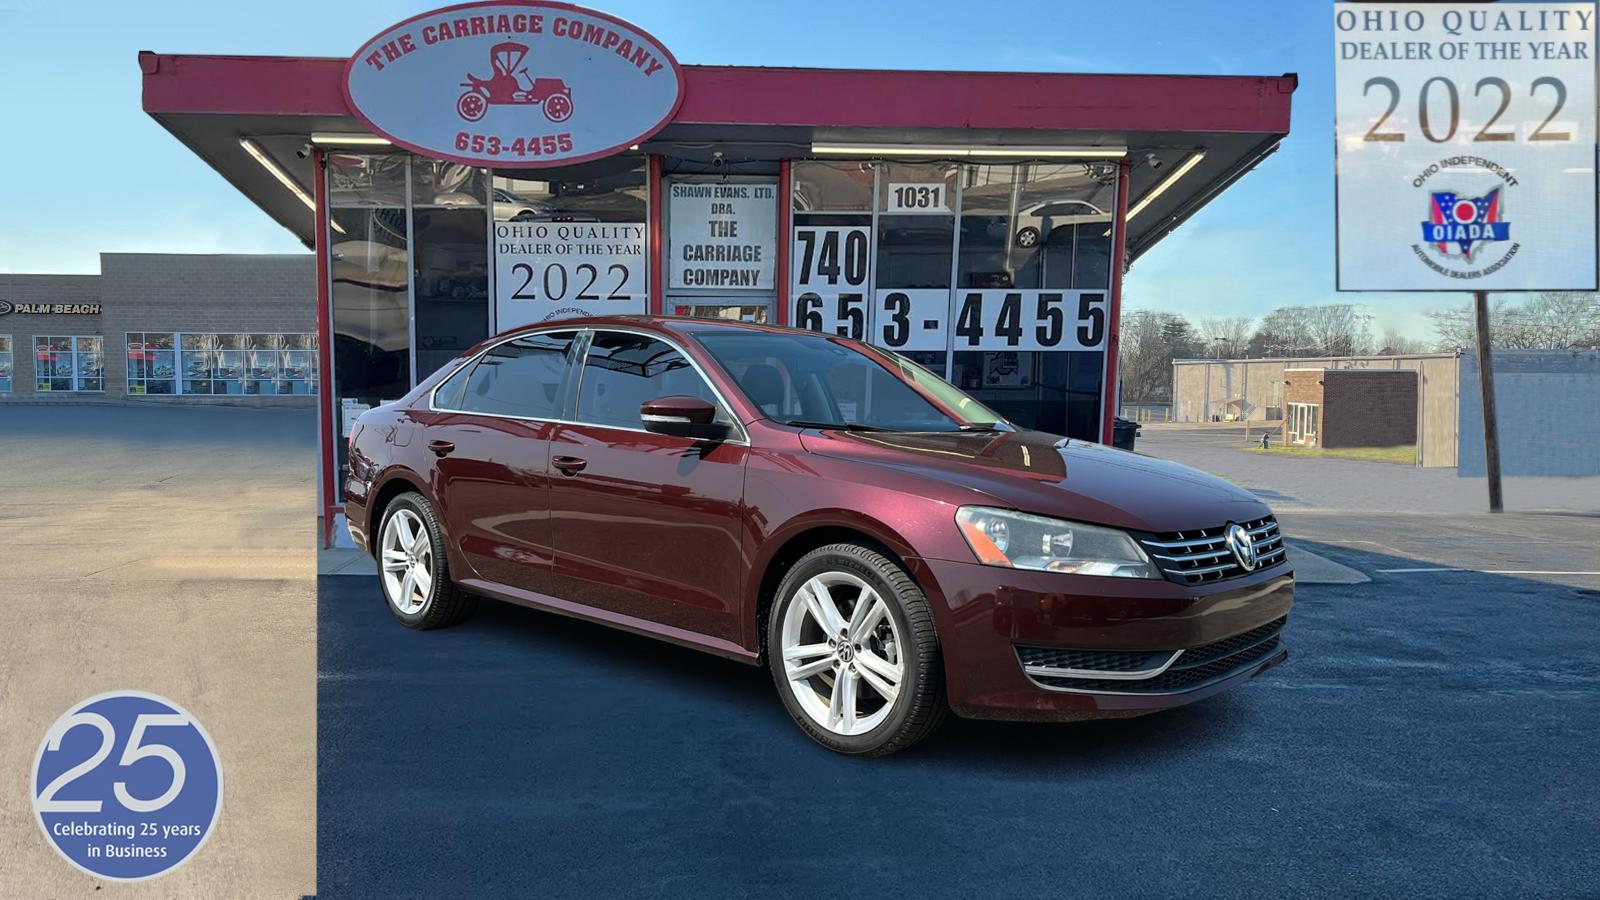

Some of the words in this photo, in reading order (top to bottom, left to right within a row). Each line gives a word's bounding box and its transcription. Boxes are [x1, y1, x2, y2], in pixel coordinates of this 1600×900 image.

[1336, 11, 1425, 32] OHIO
[1442, 10, 1593, 35] QUALITY
[365, 34, 417, 71] THE
[421, 15, 544, 46] CARRIAGE
[552, 17, 664, 77] COMPANY
[1341, 42, 1433, 60] DEALER
[1439, 42, 1470, 60] OF
[1475, 42, 1522, 60] THE
[1528, 42, 1589, 60] YEAR
[1363, 76, 1571, 143] 2022
[454, 132, 573, 156] 653-4455
[1413, 164, 1440, 188] OHIO
[1440, 155, 1519, 187] INDEPENDENT
[672, 186, 712, 198] SHAWN
[754, 187, 774, 199] LTD.
[894, 186, 940, 208] 1031
[711, 203, 735, 215] DBA.
[497, 225, 548, 239] OHIO
[557, 225, 644, 241] QUALITY
[709, 220, 738, 238] THE
[1432, 223, 1496, 241] OIADA
[499, 243, 552, 255] DEALER
[555, 243, 573, 255] OF
[576, 243, 603, 255] THE
[606, 243, 641, 255] YEAR
[683, 244, 762, 263] CARRIAGE
[797, 229, 867, 286] 740
[511, 262, 632, 301] 2022
[683, 268, 760, 286] COMPANY
[14, 303, 51, 314] PALM
[54, 304, 100, 314] BEACH
